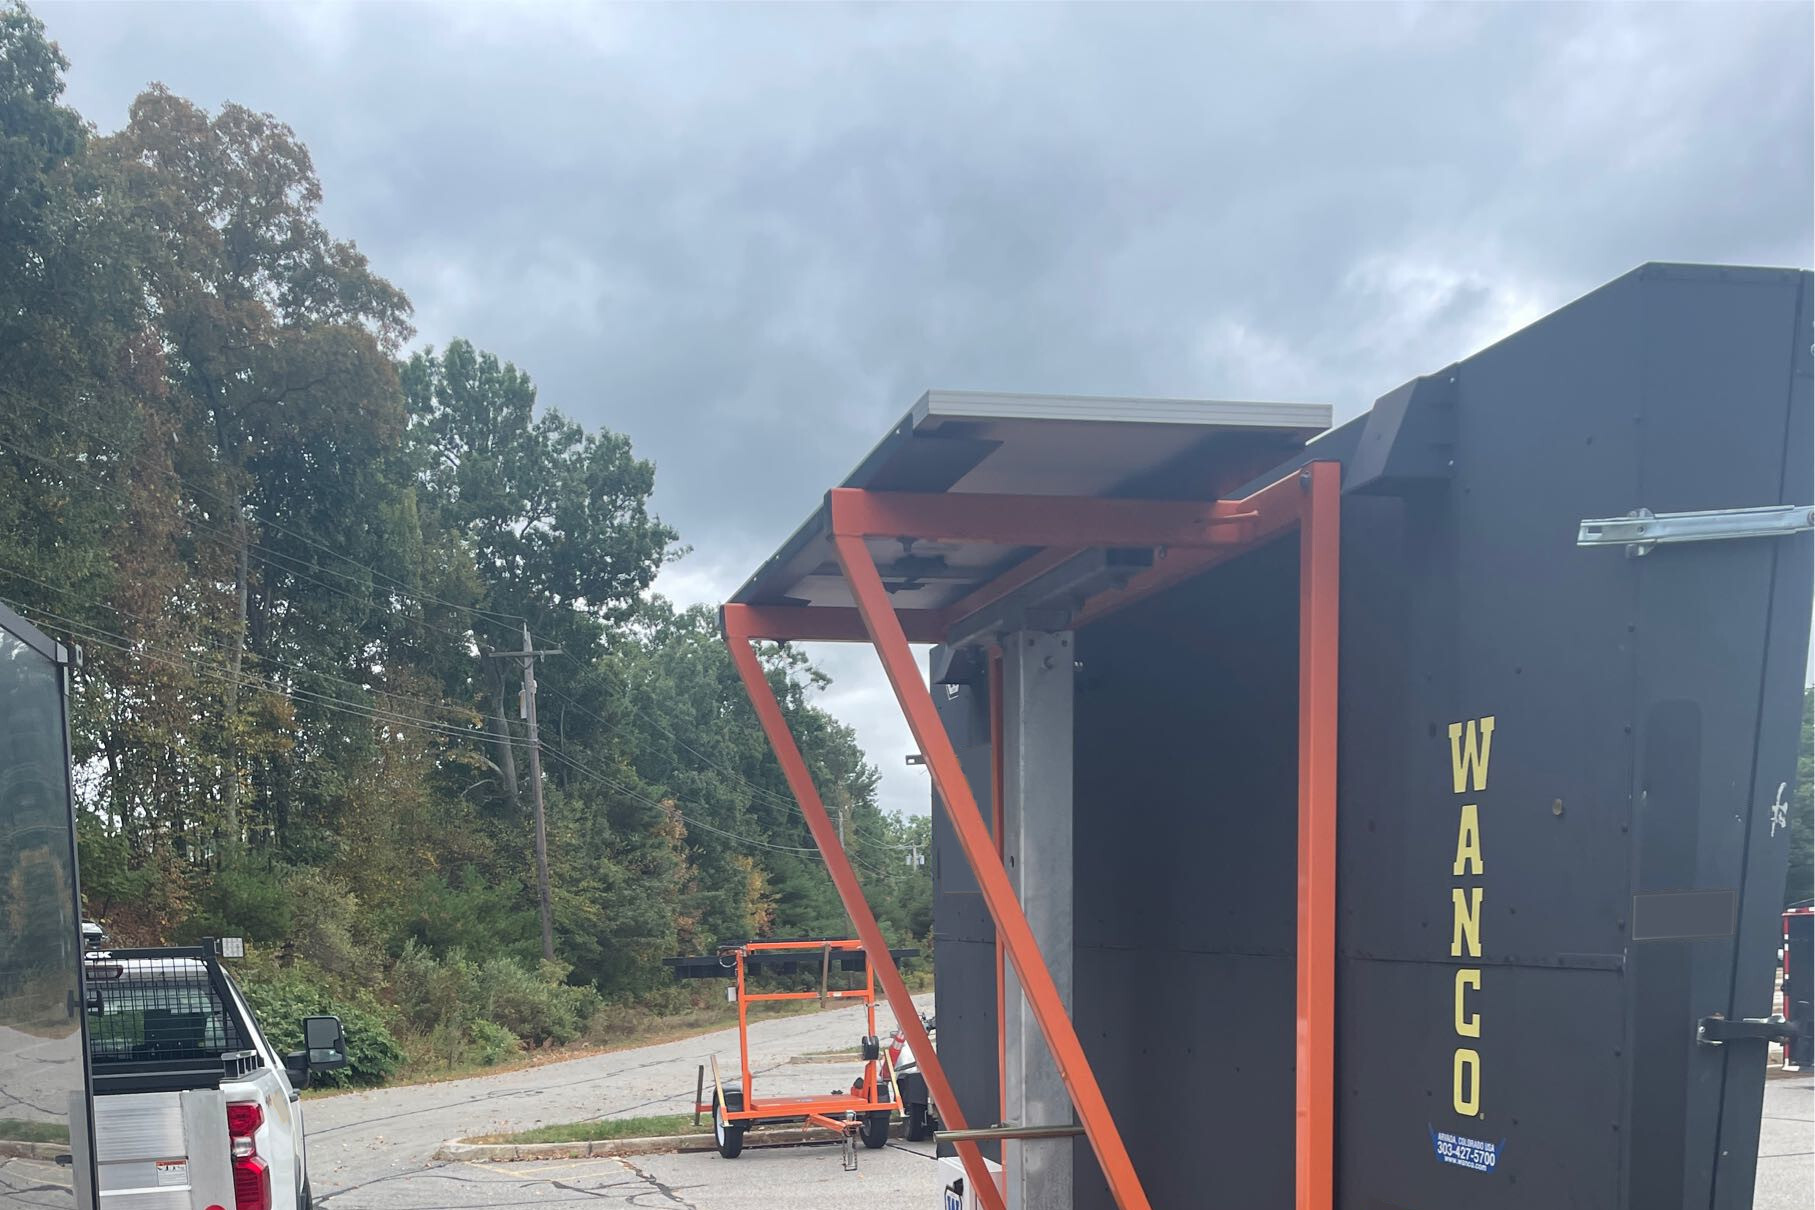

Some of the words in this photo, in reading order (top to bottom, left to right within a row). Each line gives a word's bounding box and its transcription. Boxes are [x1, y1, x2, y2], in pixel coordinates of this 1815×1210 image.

[1449, 716, 1495, 1117] WANCO
[84, 951, 112, 959] CK
[1458, 1137, 1484, 1150] COLORADO
[1484, 1143, 1495, 1152] USA
[1437, 1141, 1496, 1166] 303-427-5700
[1444, 1156, 1487, 1171] www.wanco.com
